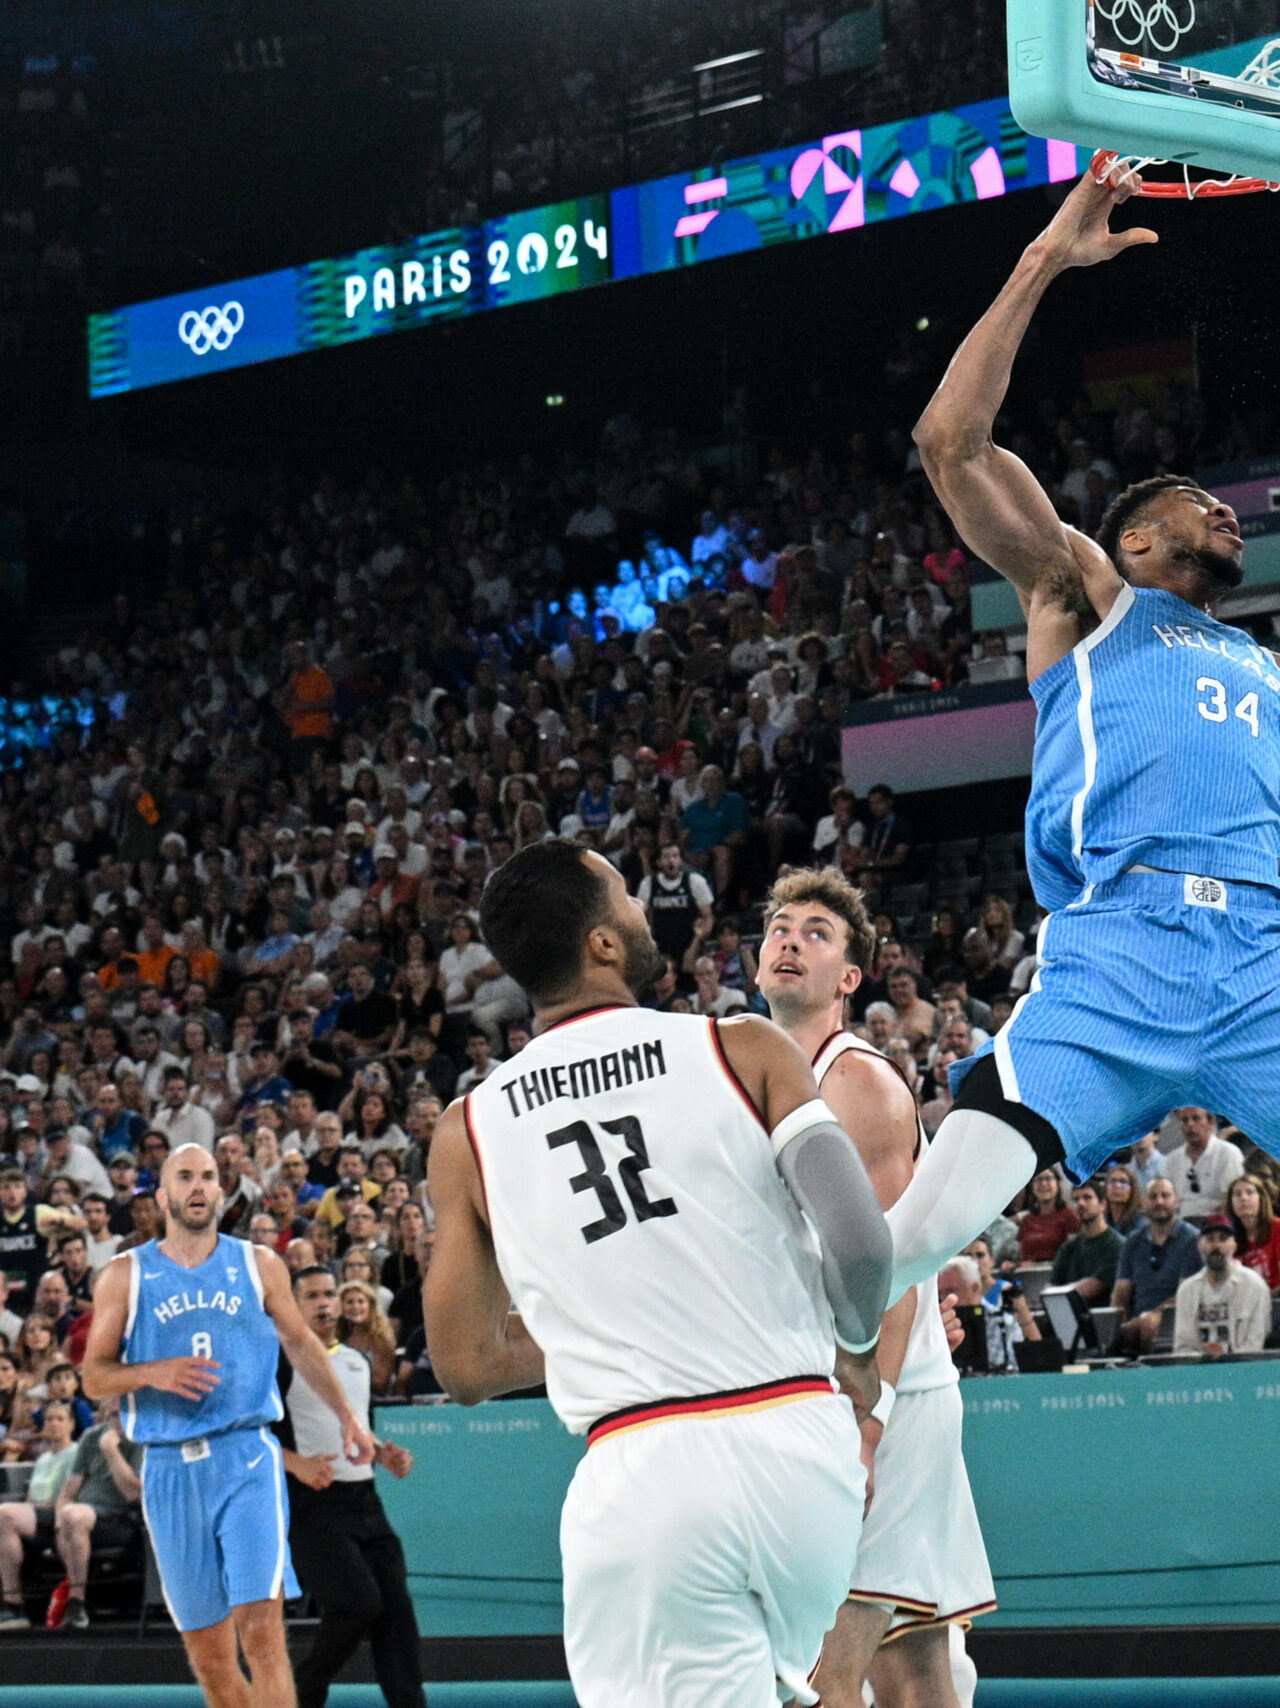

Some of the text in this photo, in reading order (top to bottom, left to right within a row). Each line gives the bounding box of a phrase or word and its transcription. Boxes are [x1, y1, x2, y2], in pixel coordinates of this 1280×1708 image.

[487, 219, 608, 285] 2024
[1195, 676, 1260, 739] 34
[500, 1039, 668, 1119] THIEMANN
[545, 1114, 679, 1245] 32
[153, 1290, 242, 1324] HELLAS
